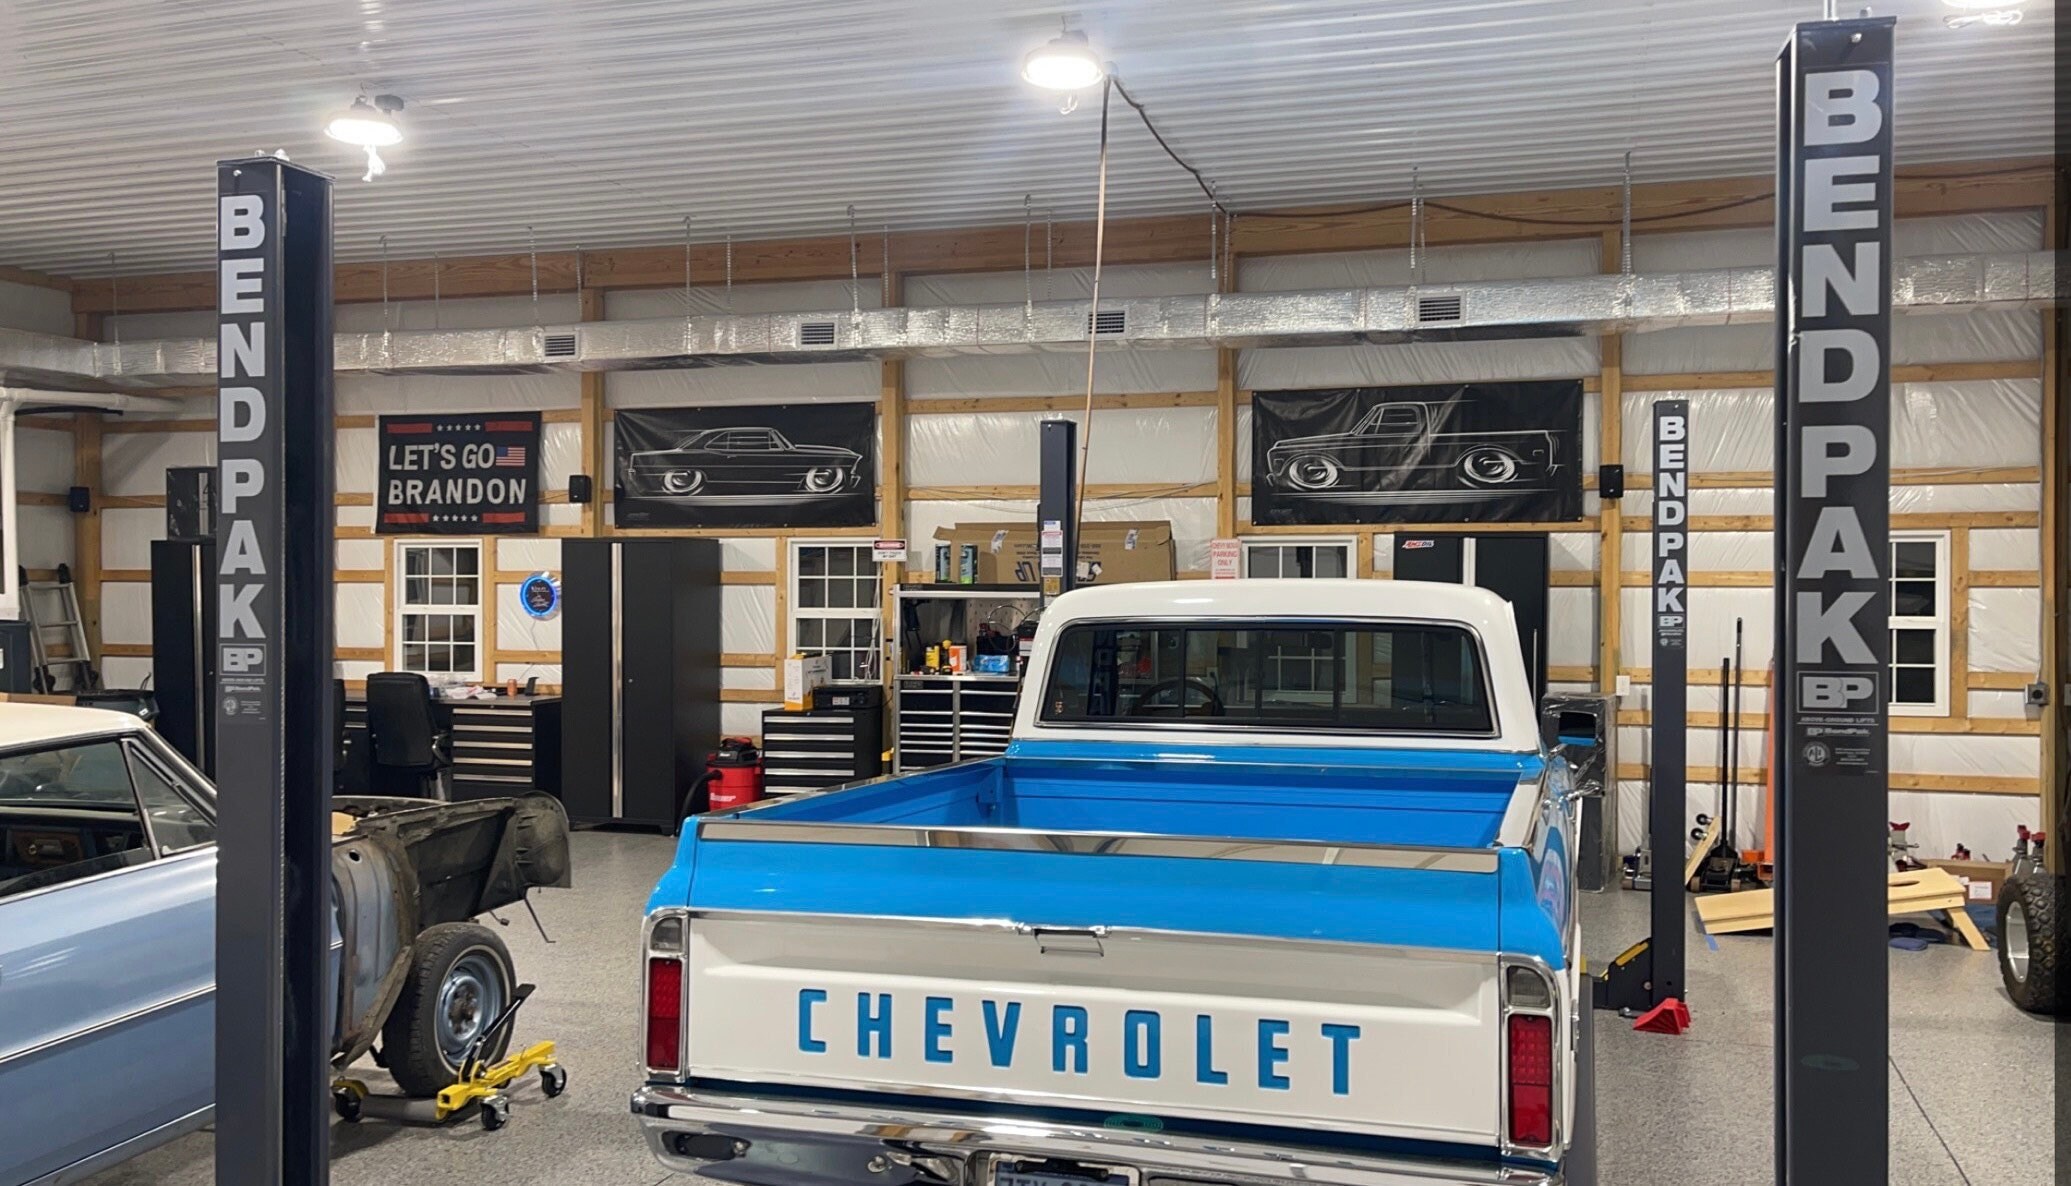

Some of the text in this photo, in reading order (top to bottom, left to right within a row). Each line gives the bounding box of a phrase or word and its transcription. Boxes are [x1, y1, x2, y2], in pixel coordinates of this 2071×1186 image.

[389, 442, 496, 470] LET'S GO
[388, 477, 527, 504] BRANDON
[1660, 616, 1683, 627] BP
[223, 648, 263, 672] BP
[1803, 677, 1874, 709] BP
[799, 989, 1361, 1095] CHEVROLET
